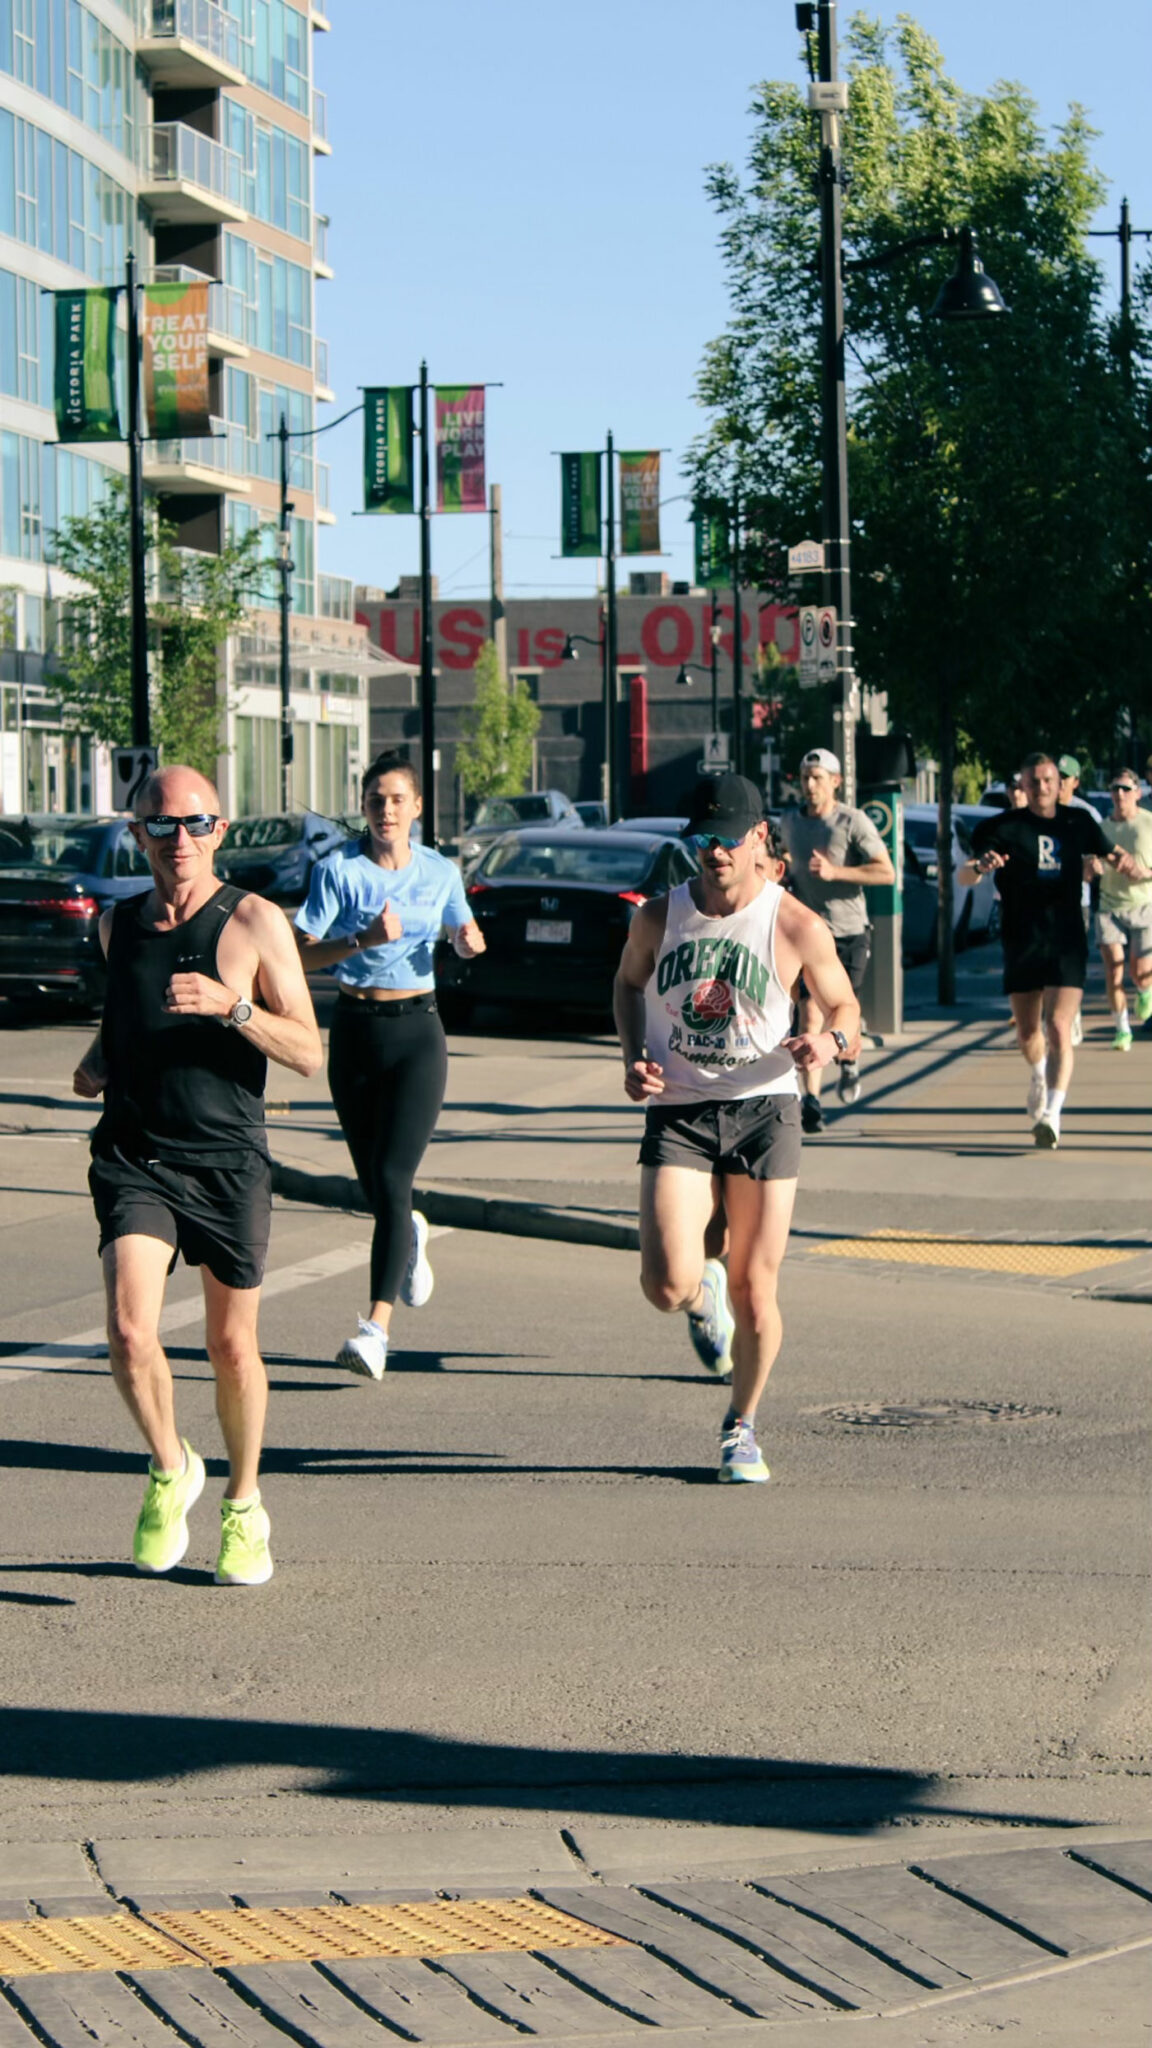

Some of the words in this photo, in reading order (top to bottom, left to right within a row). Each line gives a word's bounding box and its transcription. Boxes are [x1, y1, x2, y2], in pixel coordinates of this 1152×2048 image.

[70, 303, 82, 342] PARK
[147, 333, 207, 351] YOUR
[152, 352, 207, 371] SELF
[445, 411, 484, 426] LIVE
[441, 443, 484, 457] PLAY
[355, 608, 486, 670] US
[517, 627, 565, 667] IS
[657, 938, 770, 1007] OREGON
